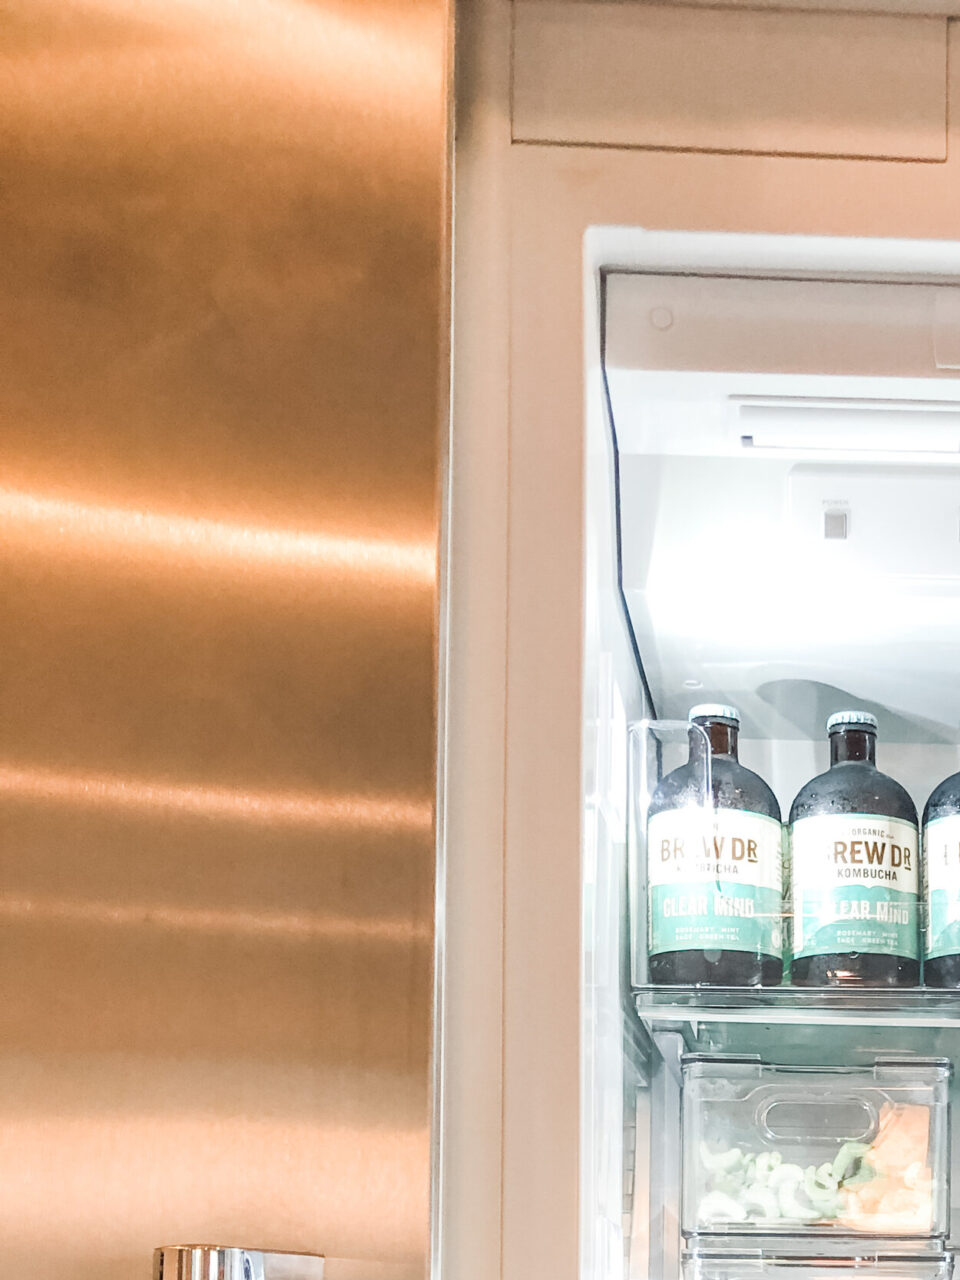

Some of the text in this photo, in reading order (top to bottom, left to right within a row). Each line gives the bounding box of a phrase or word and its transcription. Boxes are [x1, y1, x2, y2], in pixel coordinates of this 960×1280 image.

[661, 836, 758, 863] BRW DR
[828, 840, 912, 871] REW DR
[838, 867, 898, 881] KOMBUCHA
[664, 896, 754, 918] CLEAR MIND
[877, 901, 910, 925] MIND
